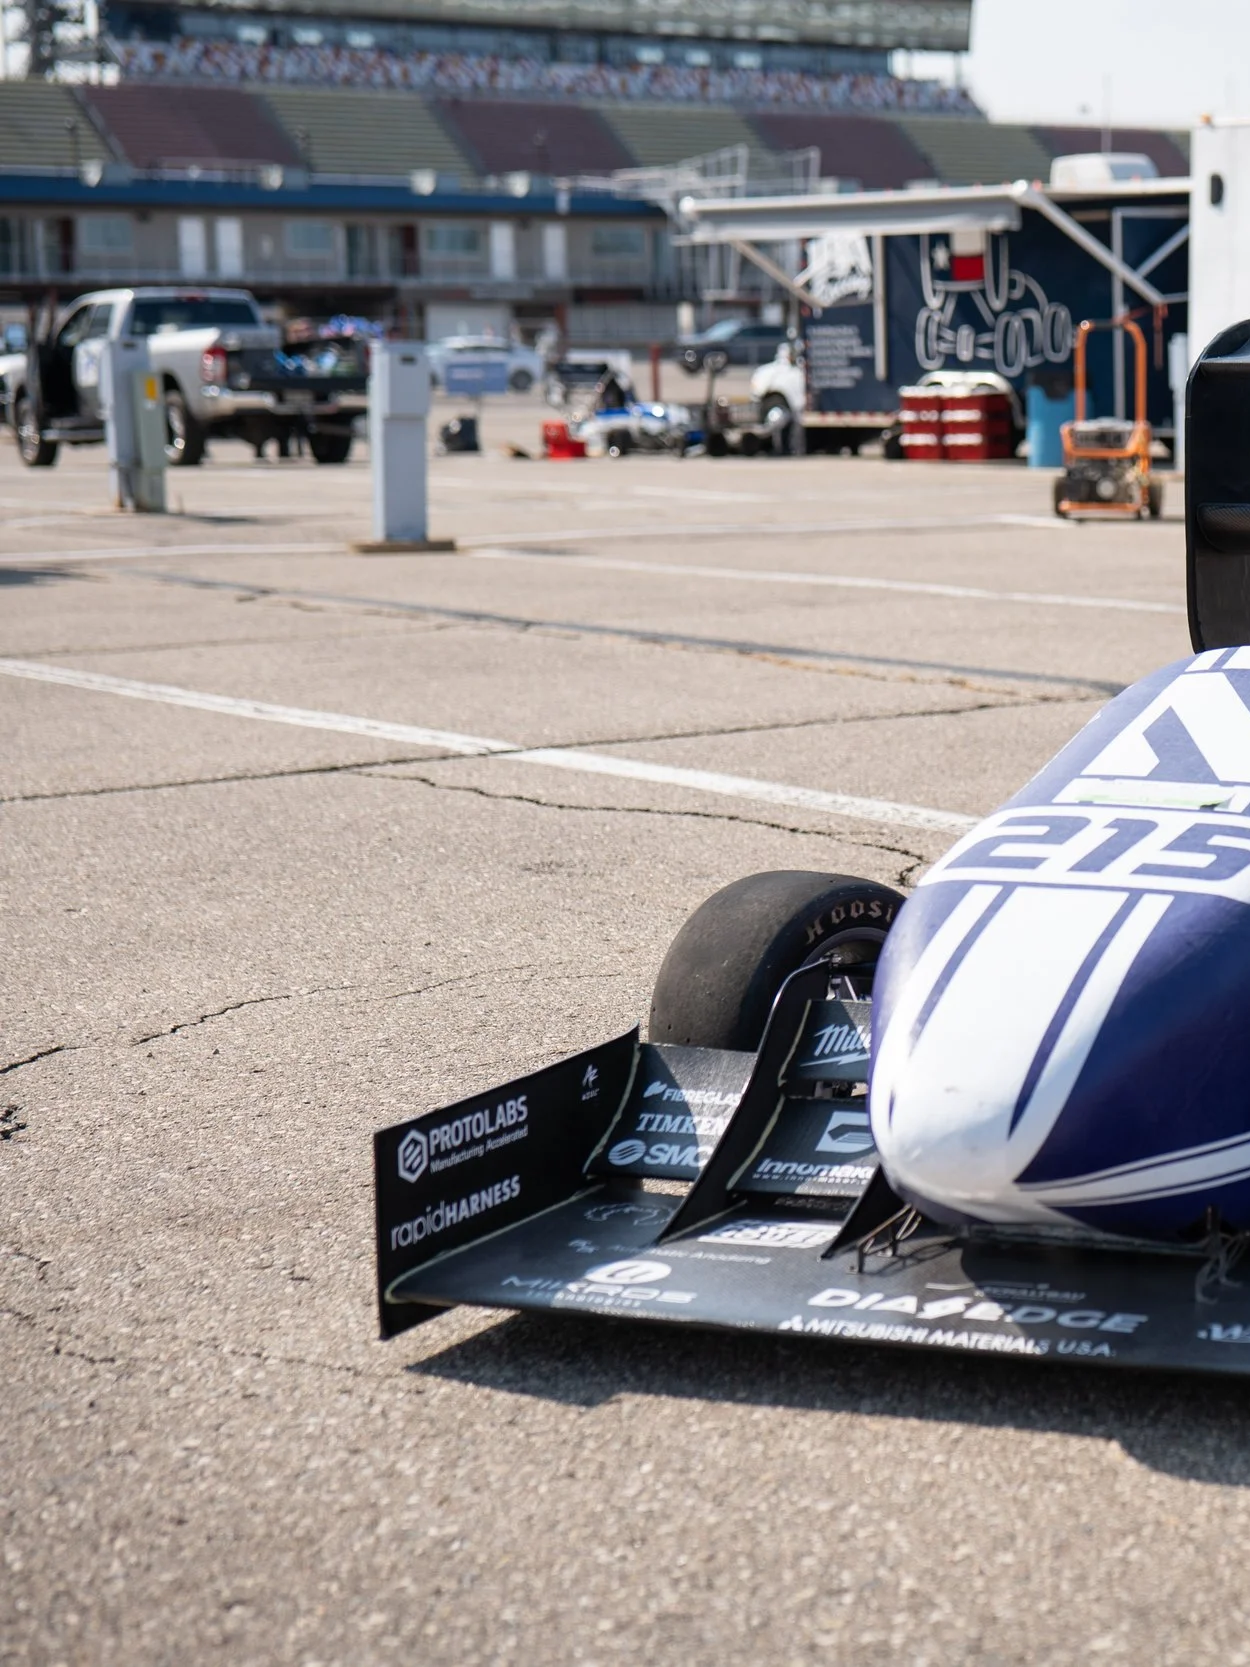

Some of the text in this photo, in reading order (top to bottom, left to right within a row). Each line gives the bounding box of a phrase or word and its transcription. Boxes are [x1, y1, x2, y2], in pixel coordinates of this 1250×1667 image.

[429, 1095, 528, 1156] PROTOLABS
[430, 1123, 529, 1174] Manufacturing Accelerated
[643, 1143, 715, 1167] SMC
[804, 1317, 926, 1344] MITSUBISHI
[928, 1326, 1049, 1355] MATERIALS
